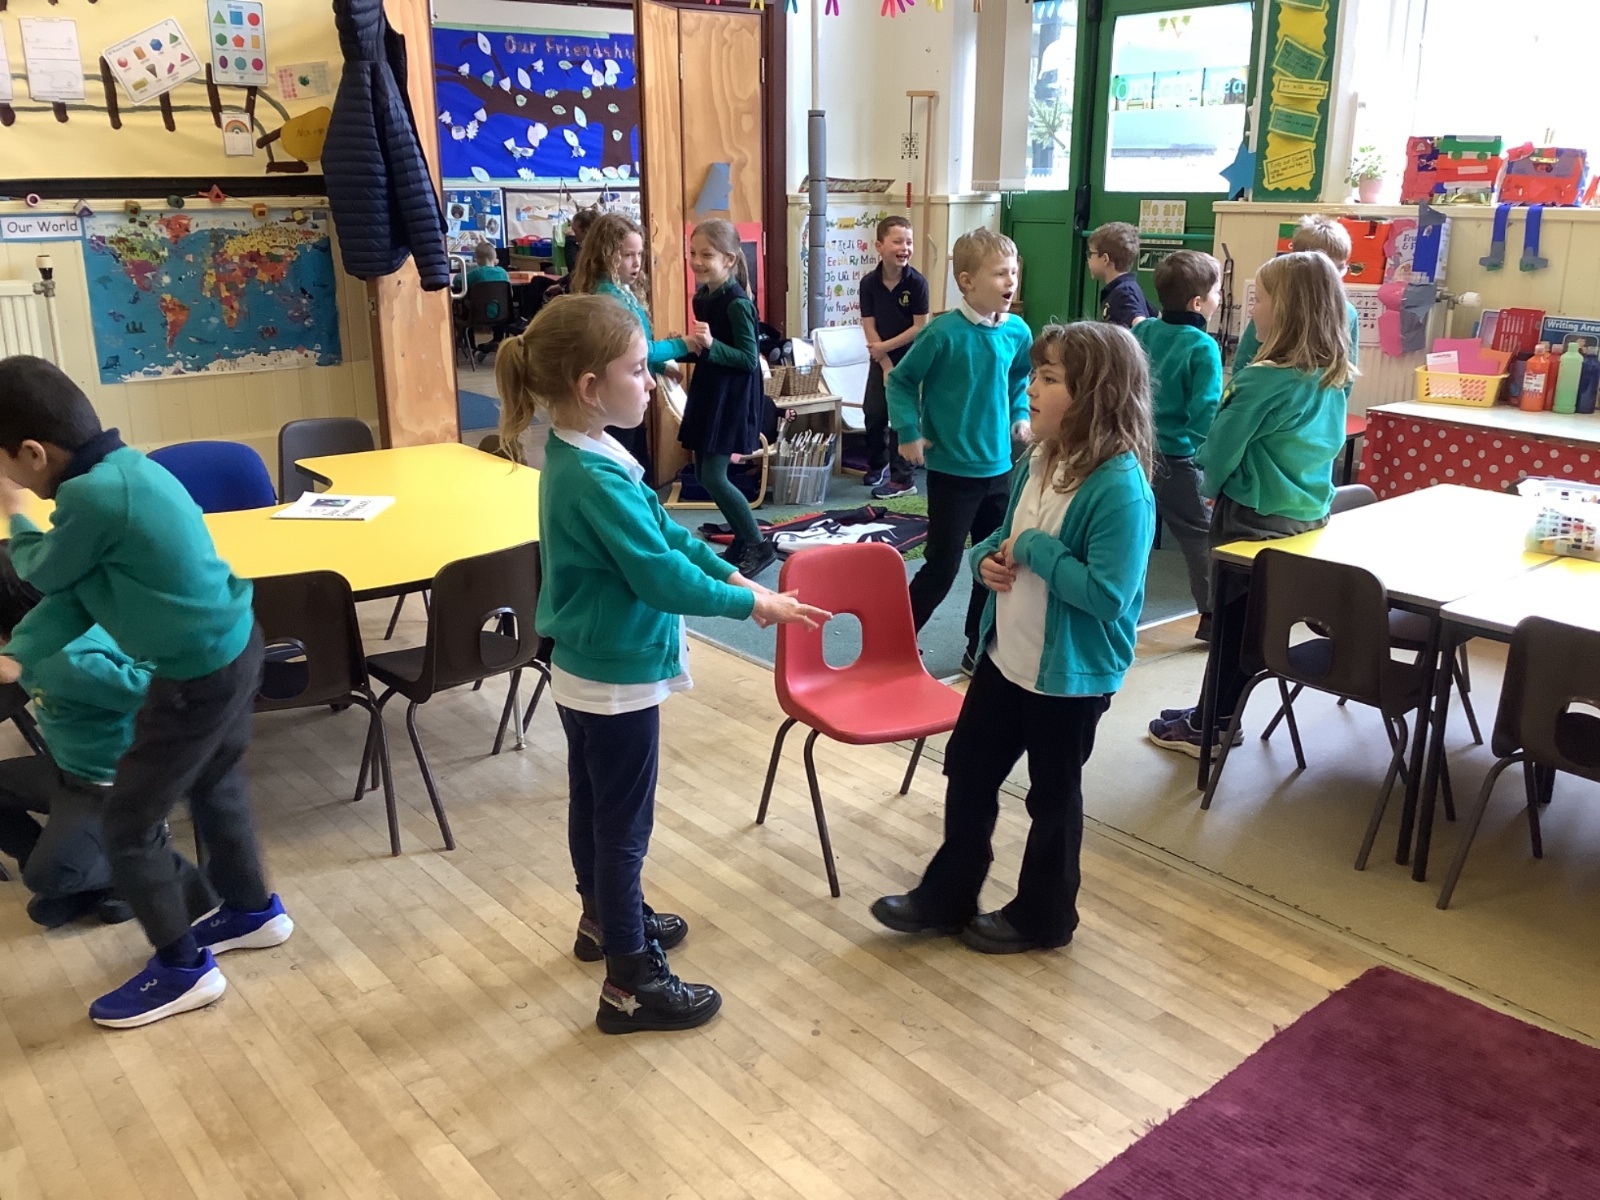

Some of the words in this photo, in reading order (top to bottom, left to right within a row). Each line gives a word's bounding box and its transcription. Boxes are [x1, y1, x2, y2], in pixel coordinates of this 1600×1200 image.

[504, 35, 537, 54] Our
[545, 38, 635, 60] Friendshi
[1141, 200, 1159, 216] We
[1163, 204, 1185, 217] are
[7, 221, 32, 233] Our
[37, 220, 78, 232] World
[1403, 233, 1417, 242] Fru
[1547, 320, 1579, 332] Writing
